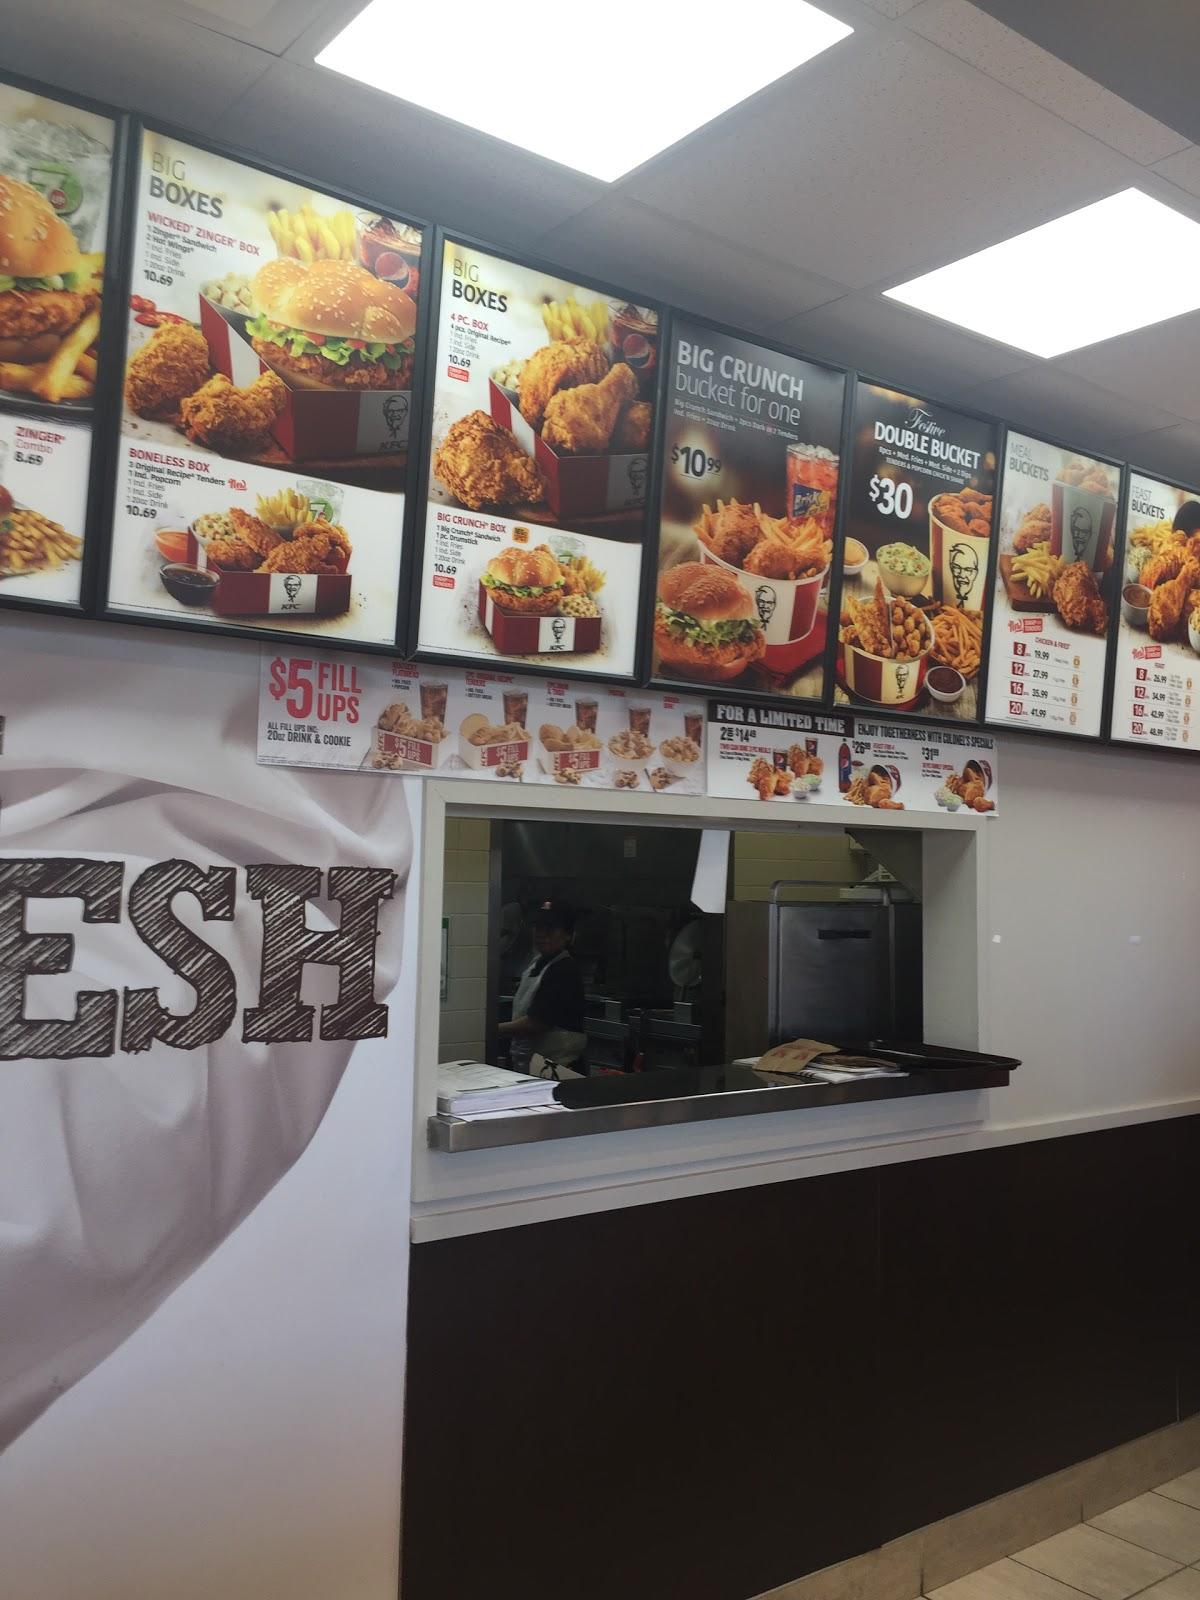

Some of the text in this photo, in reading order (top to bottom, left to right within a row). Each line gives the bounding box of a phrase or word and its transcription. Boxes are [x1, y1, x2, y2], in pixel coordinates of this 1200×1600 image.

[151, 152, 186, 181] BIG
[149, 175, 223, 218] BOXES
[182, 236, 217, 252] Sandwich
[239, 241, 260, 255] BOX
[143, 270, 173, 286] 10.69
[453, 259, 480, 283] BIG
[452, 278, 508, 313] BOXES
[450, 313, 456, 322] 4
[472, 319, 489, 332] BOX
[467, 329, 490, 341] Original
[448, 354, 471, 368] 10.69
[677, 340, 804, 402] BIG CRUNCH
[675, 365, 801, 426] bucket for one
[874, 421, 981, 470] DOUBLE BUCKET
[1011, 443, 1033, 461] MEAL
[129, 448, 210, 473] BONELESS BOX
[1009, 458, 1049, 482] BUCKETS
[135, 462, 165, 475] Original
[196, 474, 226, 486] Tenders
[150, 474, 182, 486] Popcorn
[868, 474, 914, 519] $30
[126, 504, 157, 519] 10.69
[1131, 498, 1166, 520] BUCKETS
[437, 512, 451, 523] BIG
[490, 522, 507, 534] BOX
[441, 525, 450, 534] Big
[475, 532, 501, 542] Sandwich
[450, 534, 479, 546] Drumstick
[434, 563, 457, 575] 10.69
[1034, 649, 1050, 661] 19.99
[1032, 669, 1049, 680] 27.99
[269, 657, 362, 719] $5 FILL
[1031, 688, 1048, 700] 35.99
[317, 693, 360, 724] UPS
[1030, 708, 1047, 719] 41.99
[268, 722, 279, 731] ALL
[280, 723, 293, 732] FILL
[294, 723, 306, 733] UPS
[717, 704, 846, 734] FOR A LIMITED TIME
[287, 731, 312, 744] DRINK
[314, 736, 320, 745] &
[323, 736, 352, 747] COOKIE
[858, 723, 878, 736] ENJOY
[880, 725, 927, 741] TOGETHERNESS
[927, 731, 942, 743] WITH
[970, 736, 994, 749] SPECIALS
